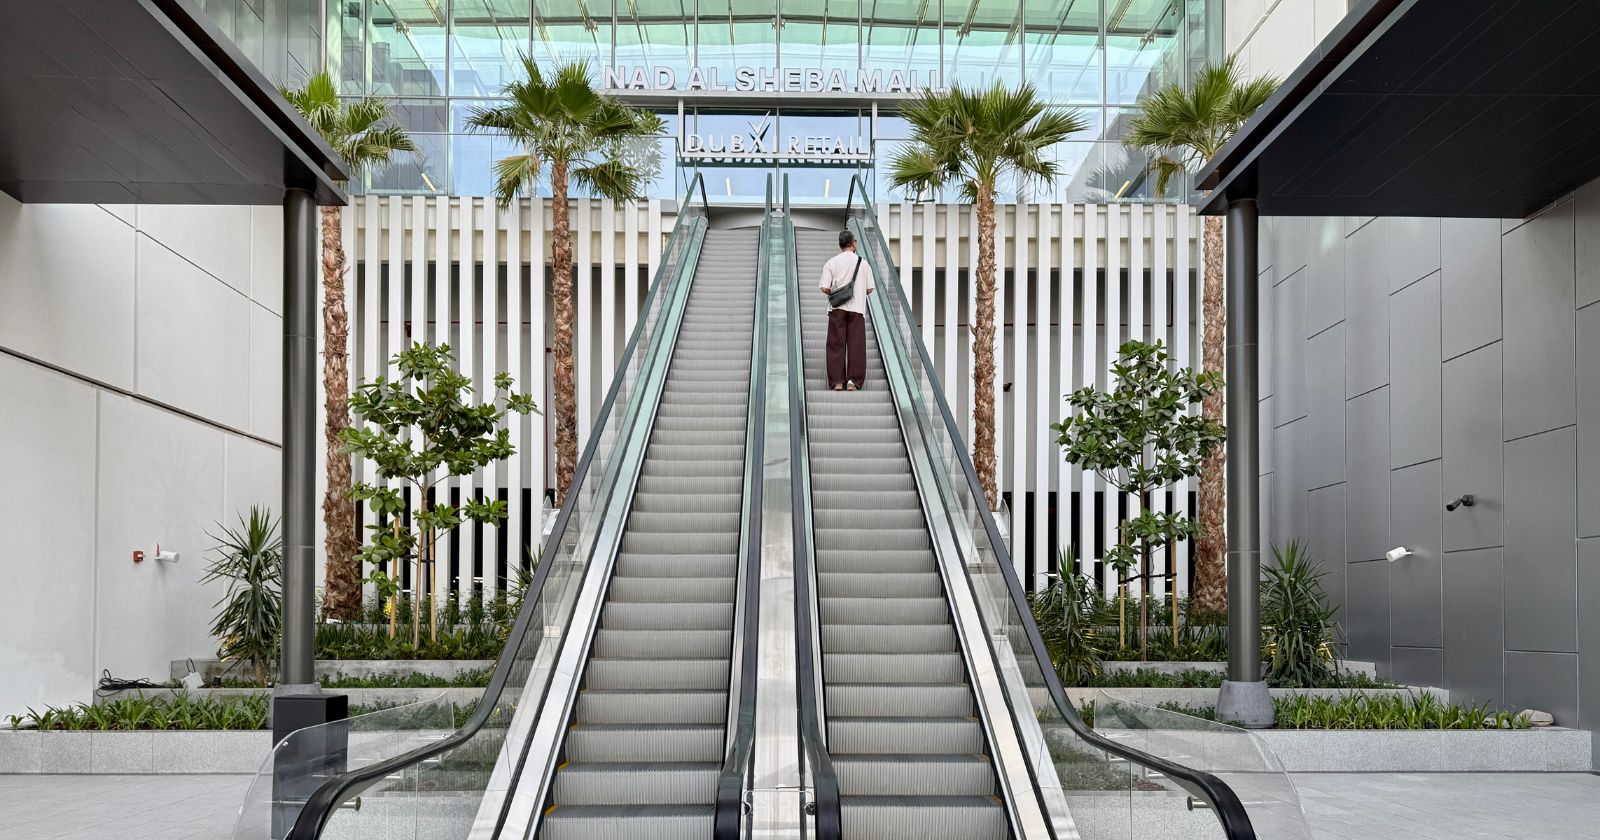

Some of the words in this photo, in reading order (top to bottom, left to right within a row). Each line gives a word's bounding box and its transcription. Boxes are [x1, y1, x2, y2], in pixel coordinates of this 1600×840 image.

[605, 65, 675, 90] NAD
[686, 66, 727, 91] AL
[735, 67, 848, 92] SHEBA
[857, 69, 945, 93] MALL
[687, 120, 778, 153] DUBAI
[788, 135, 869, 154] RETAIL
